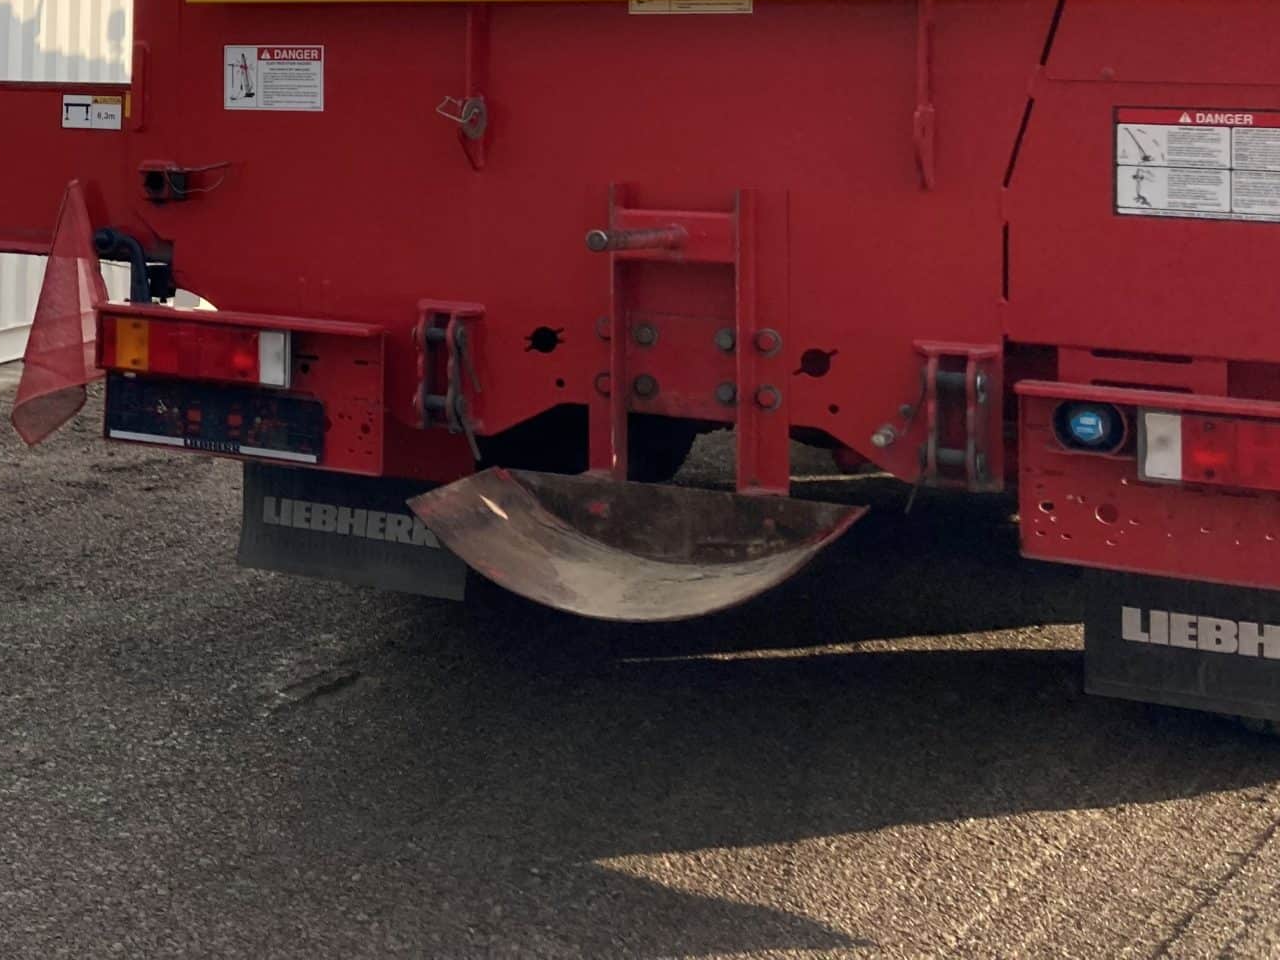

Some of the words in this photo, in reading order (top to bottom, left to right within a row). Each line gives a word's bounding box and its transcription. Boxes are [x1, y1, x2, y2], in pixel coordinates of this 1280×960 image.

[274, 49, 319, 60] DANGER
[1195, 113, 1253, 125] DANGER
[1121, 606, 1280, 660] LIEBH
